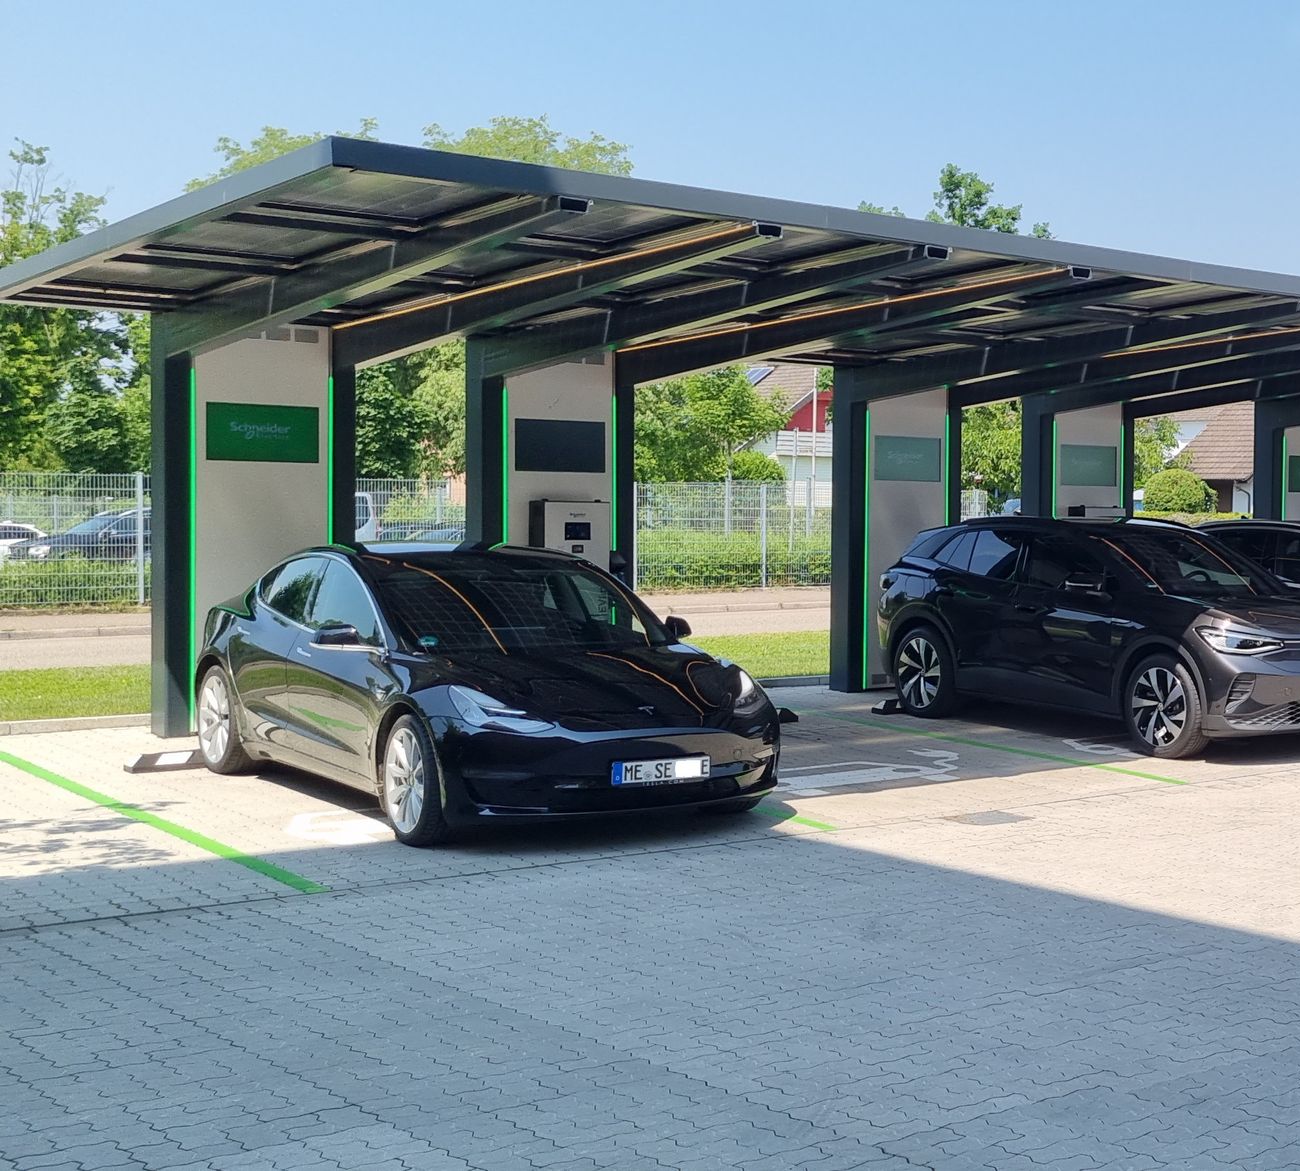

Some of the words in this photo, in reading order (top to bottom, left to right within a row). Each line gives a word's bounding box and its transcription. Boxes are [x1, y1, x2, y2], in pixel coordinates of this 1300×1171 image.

[229, 421, 291, 435] Schneider
[624, 764, 643, 781] ME
[654, 762, 673, 779] SE
